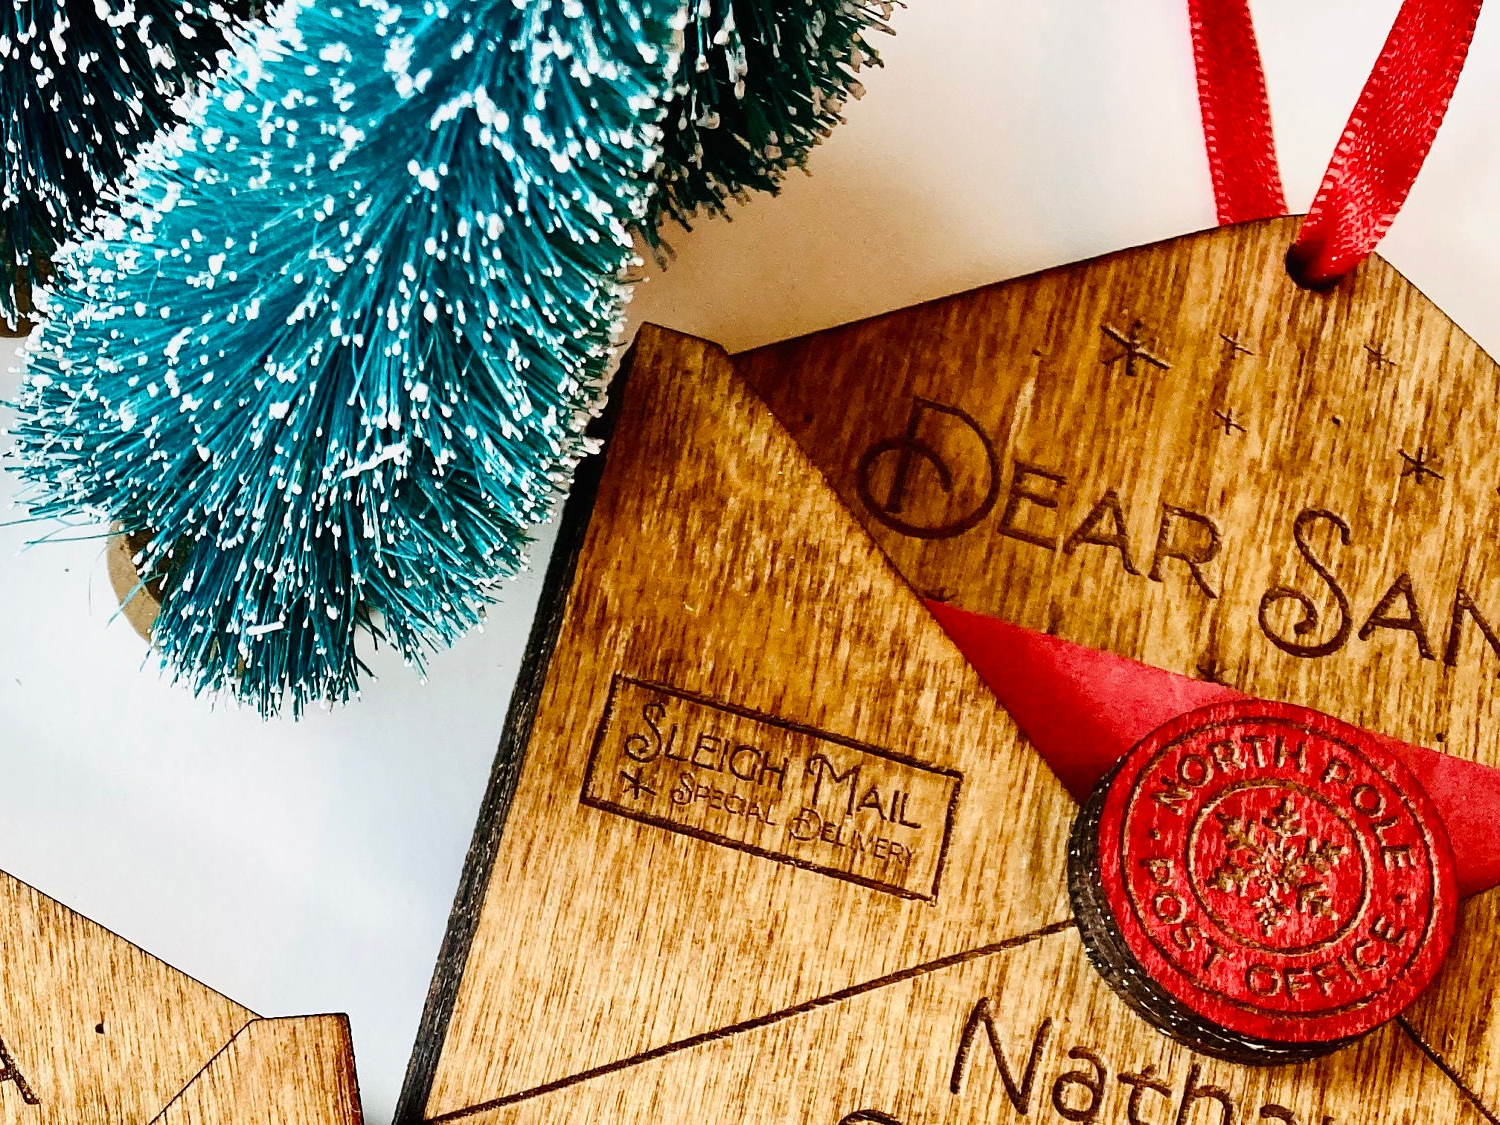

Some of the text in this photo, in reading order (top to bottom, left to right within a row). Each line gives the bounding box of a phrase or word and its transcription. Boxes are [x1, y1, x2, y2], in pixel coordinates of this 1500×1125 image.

[624, 703, 922, 828] SLEIGH MAIL
[1151, 736, 1415, 871] NORTH POLE
[1139, 857, 1406, 998] POST OFFICE
